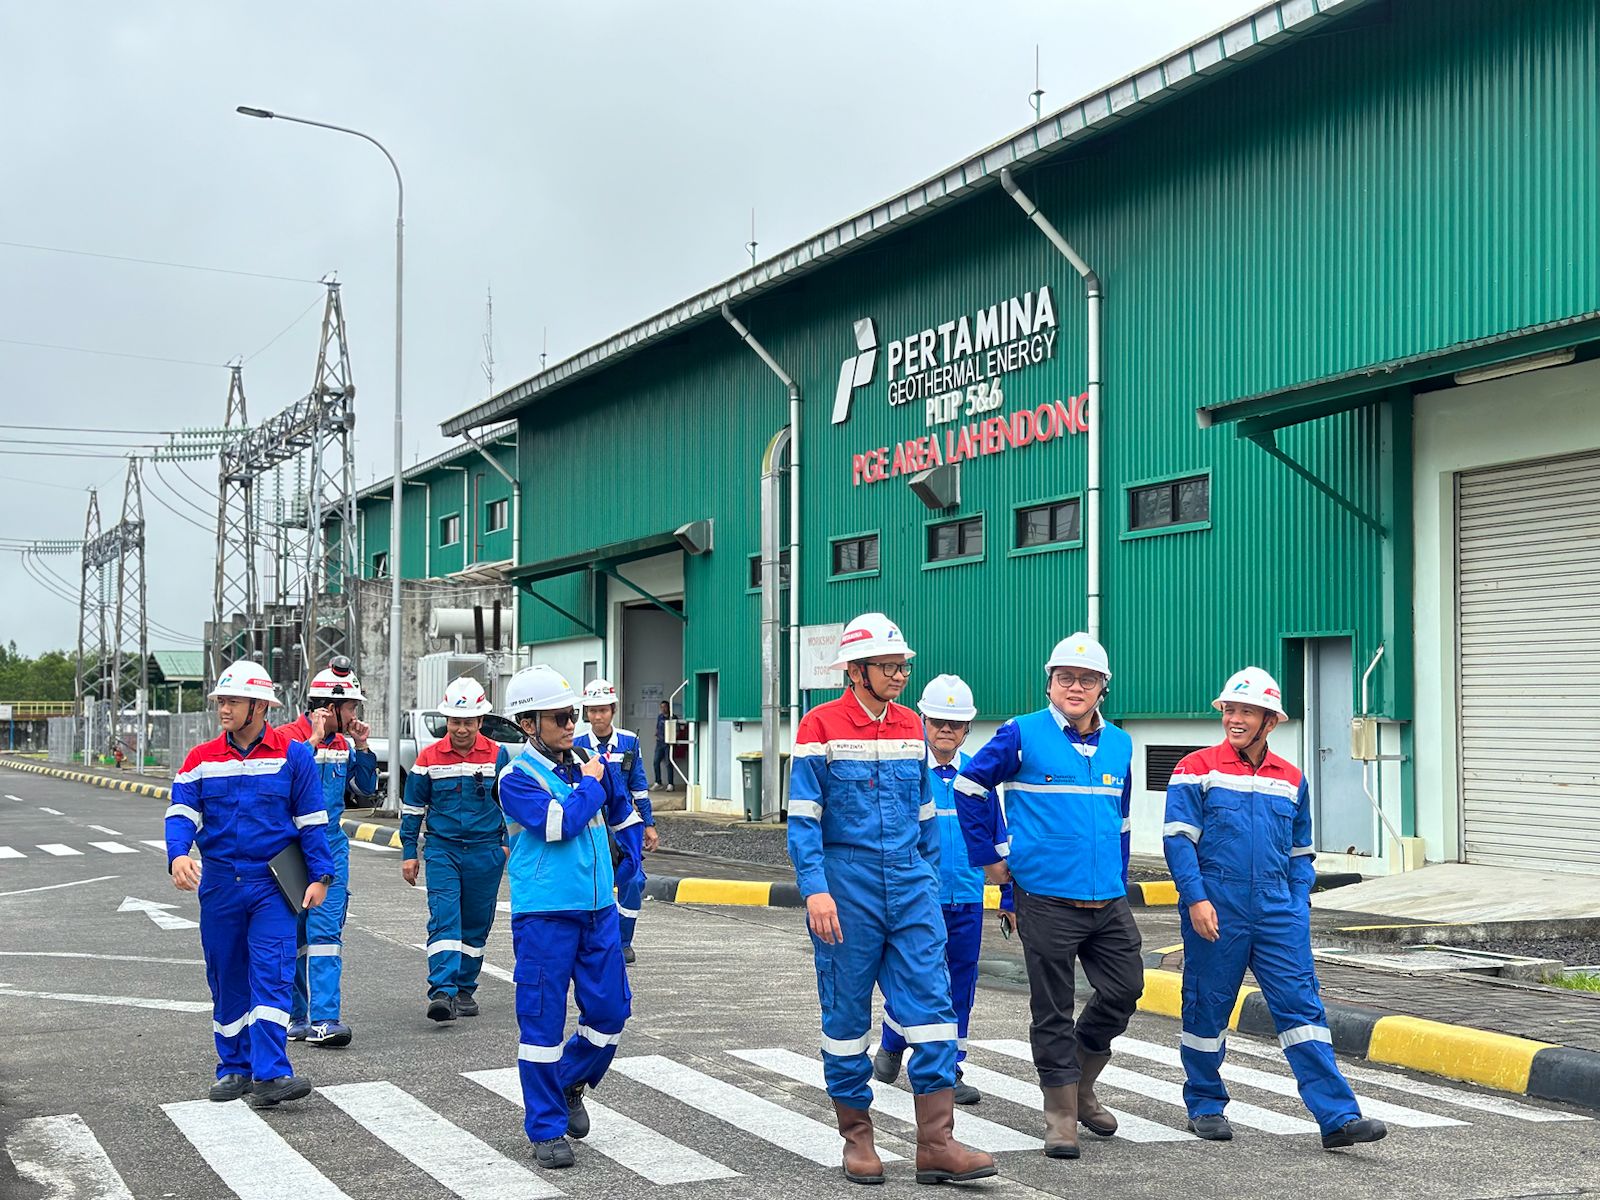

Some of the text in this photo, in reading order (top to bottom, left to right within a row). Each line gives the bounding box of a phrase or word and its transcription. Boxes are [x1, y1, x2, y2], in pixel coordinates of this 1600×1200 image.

[888, 286, 1056, 381] PERTAMINA
[889, 331, 1056, 406] GEOTHERMAL ENERGY
[926, 377, 1003, 427] PLTP 5&6
[853, 392, 1089, 486] PGE AREA LAHENDONG
[808, 636, 836, 646] WORKSHOP
[518, 696, 534, 705] SULUT
